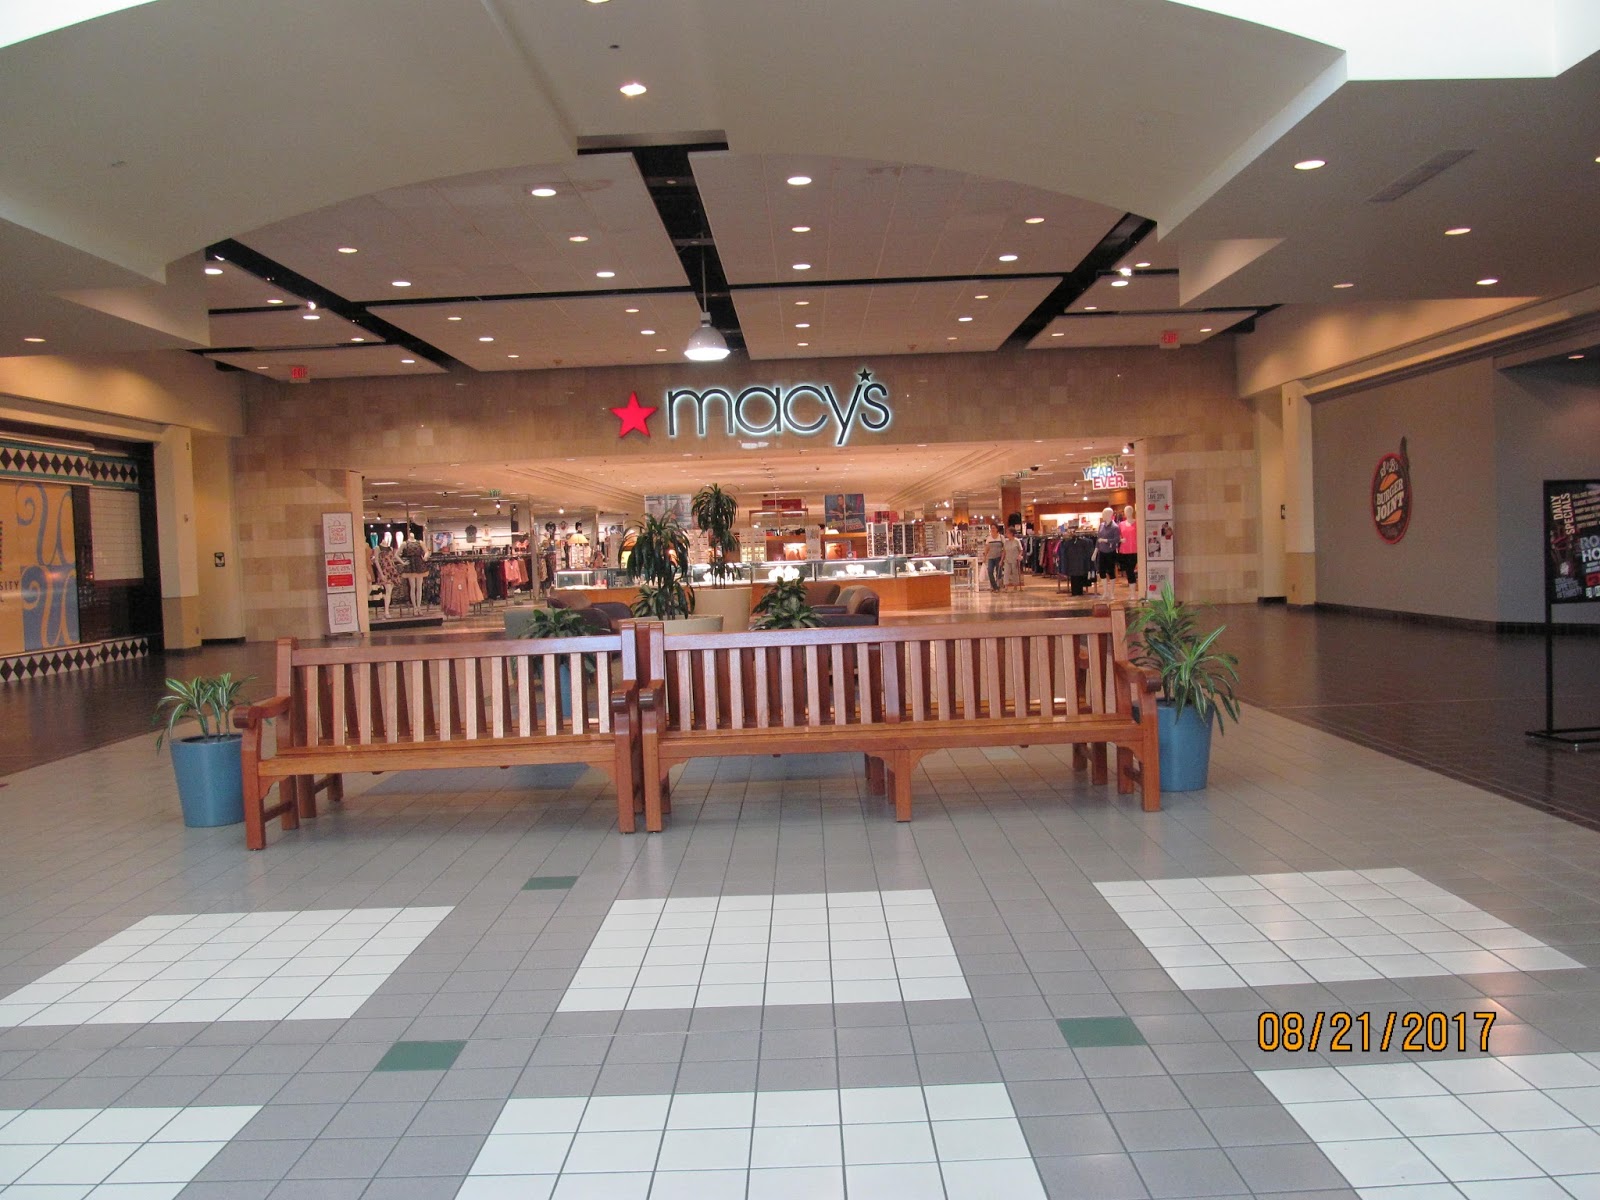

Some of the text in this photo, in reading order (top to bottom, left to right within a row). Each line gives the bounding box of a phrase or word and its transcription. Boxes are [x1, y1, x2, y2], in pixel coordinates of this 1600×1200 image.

[667, 368, 891, 445] macy's
[1082, 465, 1117, 479] YEAR.
[1091, 454, 1123, 468] BEST.
[1093, 474, 1127, 489] EVER.
[1376, 478, 1404, 505] BURGER
[1375, 491, 1405, 522] JOINT
[1550, 495, 1564, 520] DAILY
[1561, 492, 1576, 535] SPECIALS
